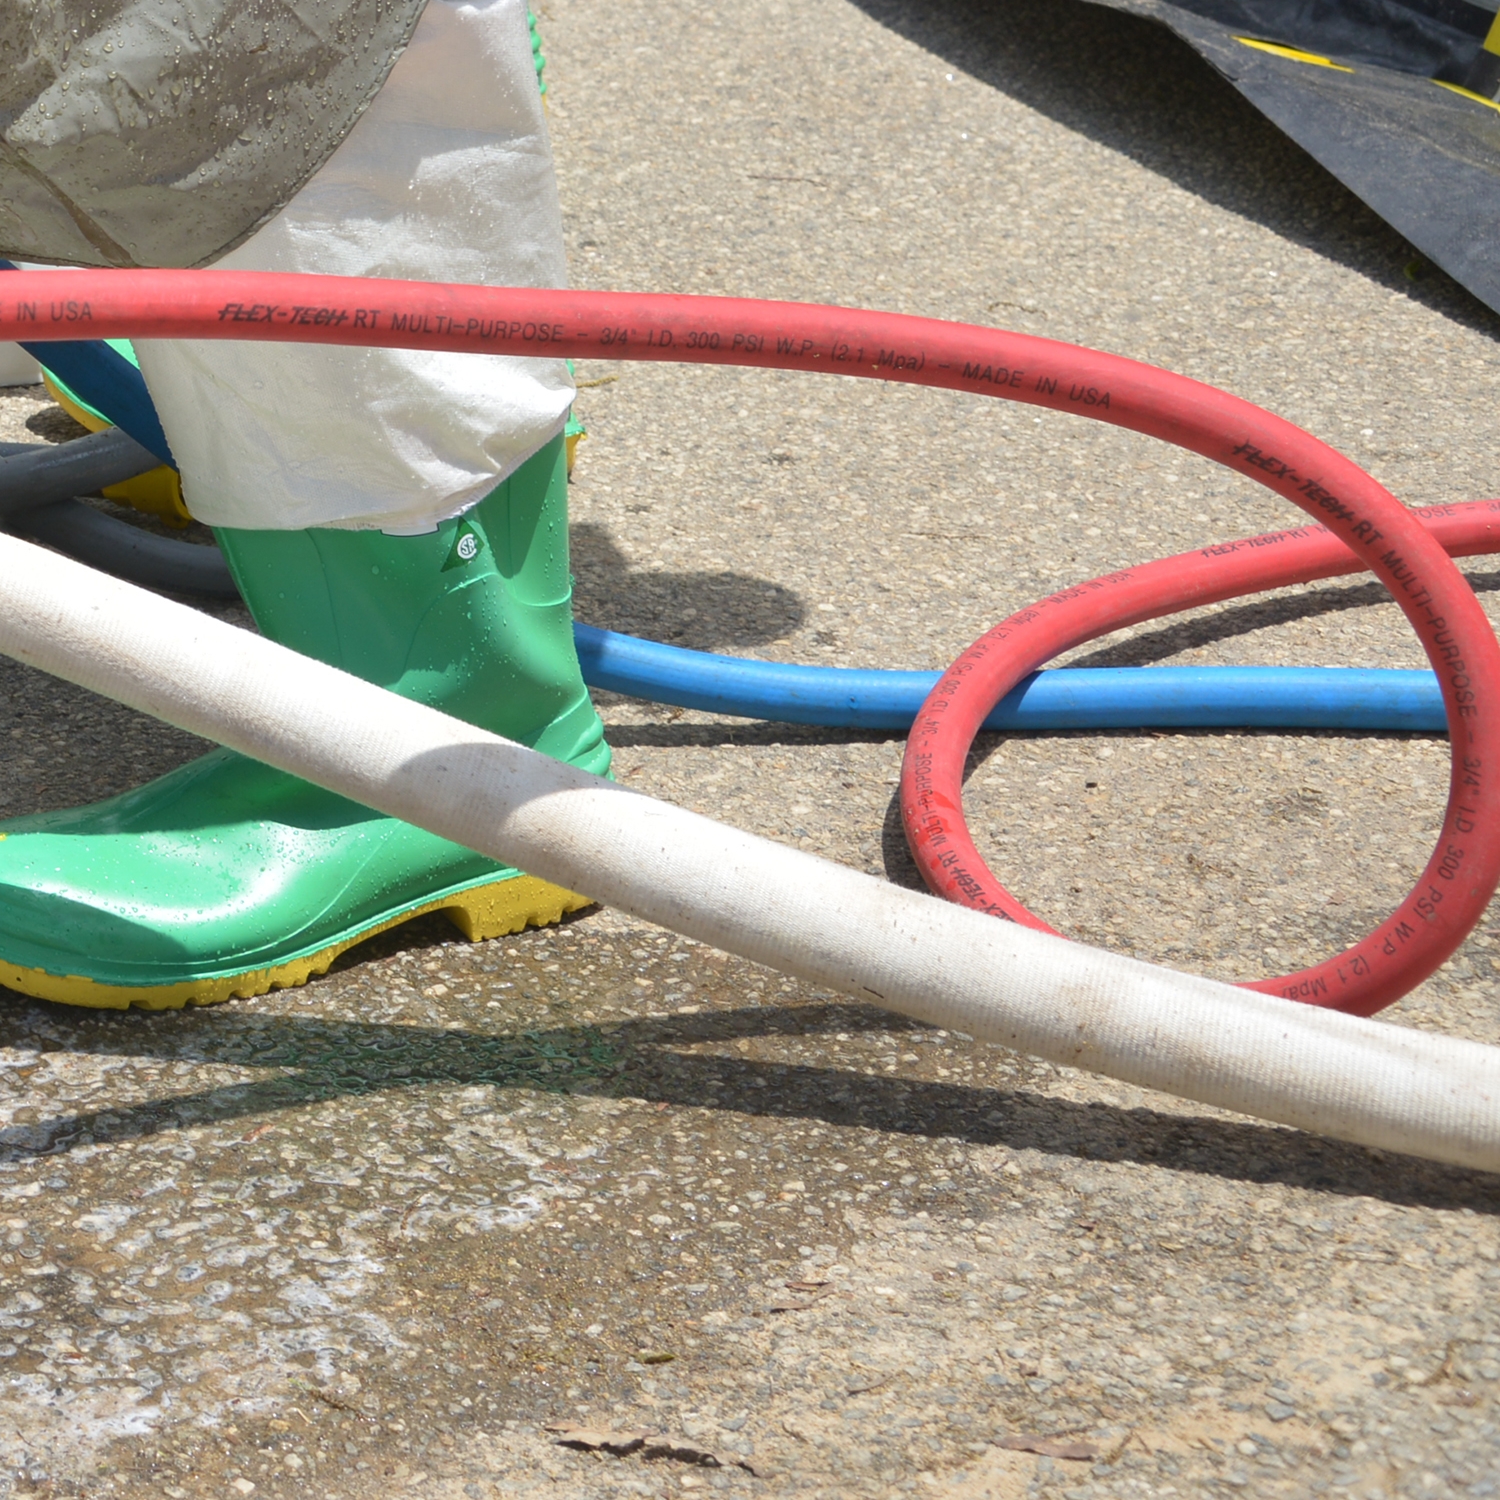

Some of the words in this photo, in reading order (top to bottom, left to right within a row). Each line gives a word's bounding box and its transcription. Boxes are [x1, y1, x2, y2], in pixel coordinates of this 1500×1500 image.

[16, 301, 37, 323] IN
[50, 300, 94, 323] USA
[353, 308, 381, 330] RT
[389, 314, 565, 344] MULTI-PURPOSE
[685, 330, 721, 351] 300
[730, 332, 765, 353] PSI
[878, 347, 926, 373] Mpa)
[961, 361, 1025, 390] MADE
[1034, 375, 1059, 396] IN
[1068, 383, 1113, 411] USA
[1351, 519, 1385, 546] RT
[1049, 586, 1088, 606] MADE
[1379, 549, 1479, 718] MULTI-PURPOSE
[939, 677, 962, 696] 300
[914, 752, 948, 848] MULTI-PURPOSE
[936, 849, 960, 869] RT
[1437, 844, 1465, 881] 300
[1412, 885, 1444, 921] PSI
